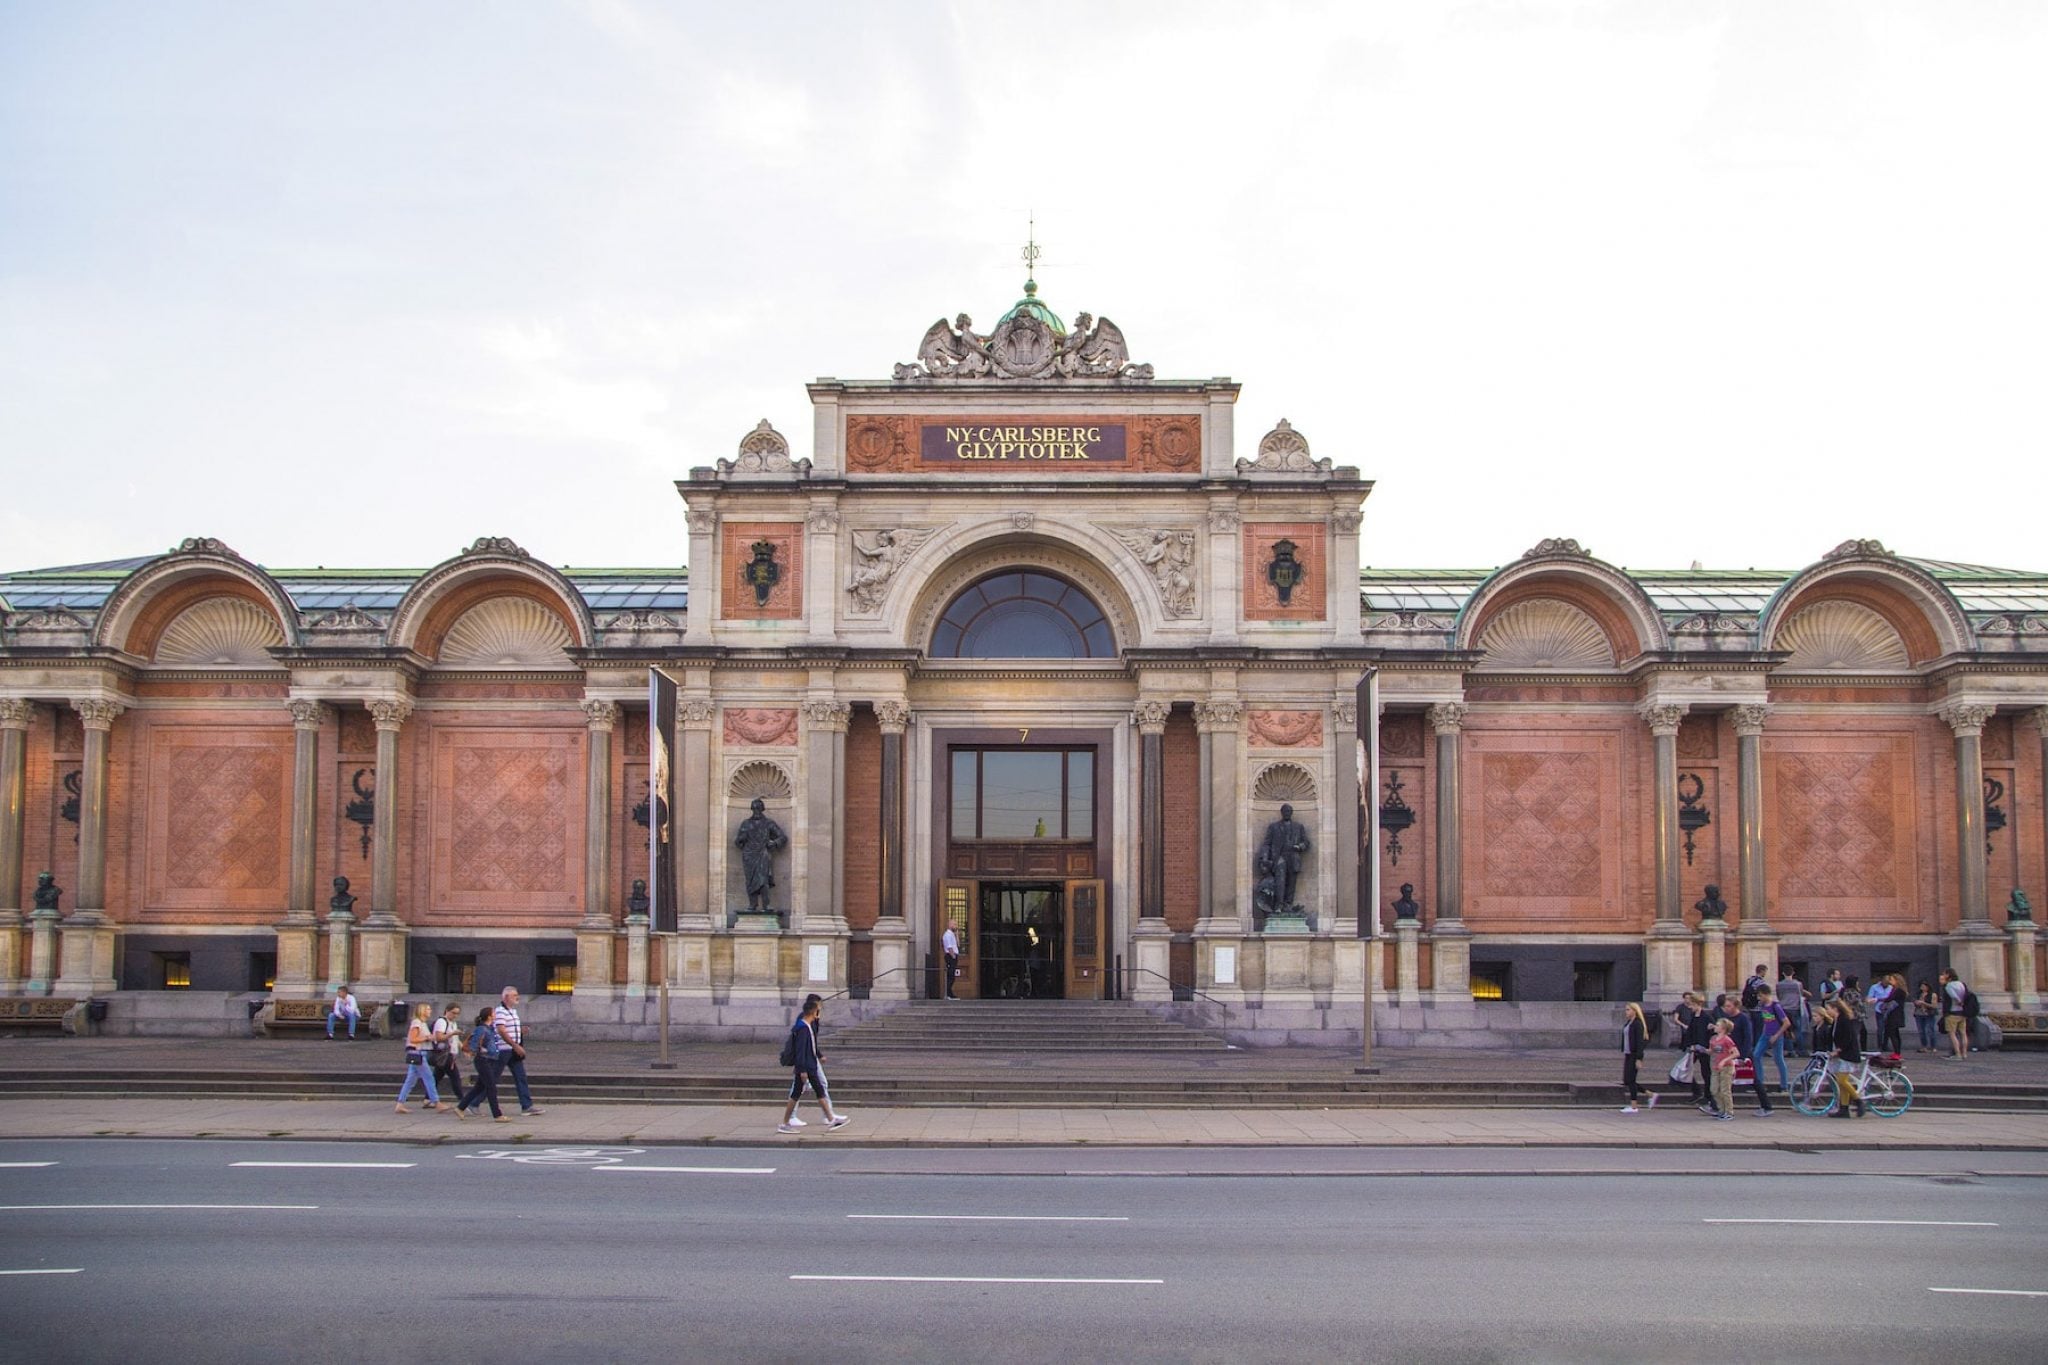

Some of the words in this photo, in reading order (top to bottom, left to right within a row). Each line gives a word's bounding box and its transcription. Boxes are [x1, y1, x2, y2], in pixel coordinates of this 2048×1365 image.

[946, 427, 1101, 442] NY-CARLSBERG
[957, 443, 1089, 459] GLYPTOTEK
[1019, 729, 1029, 743] 7
